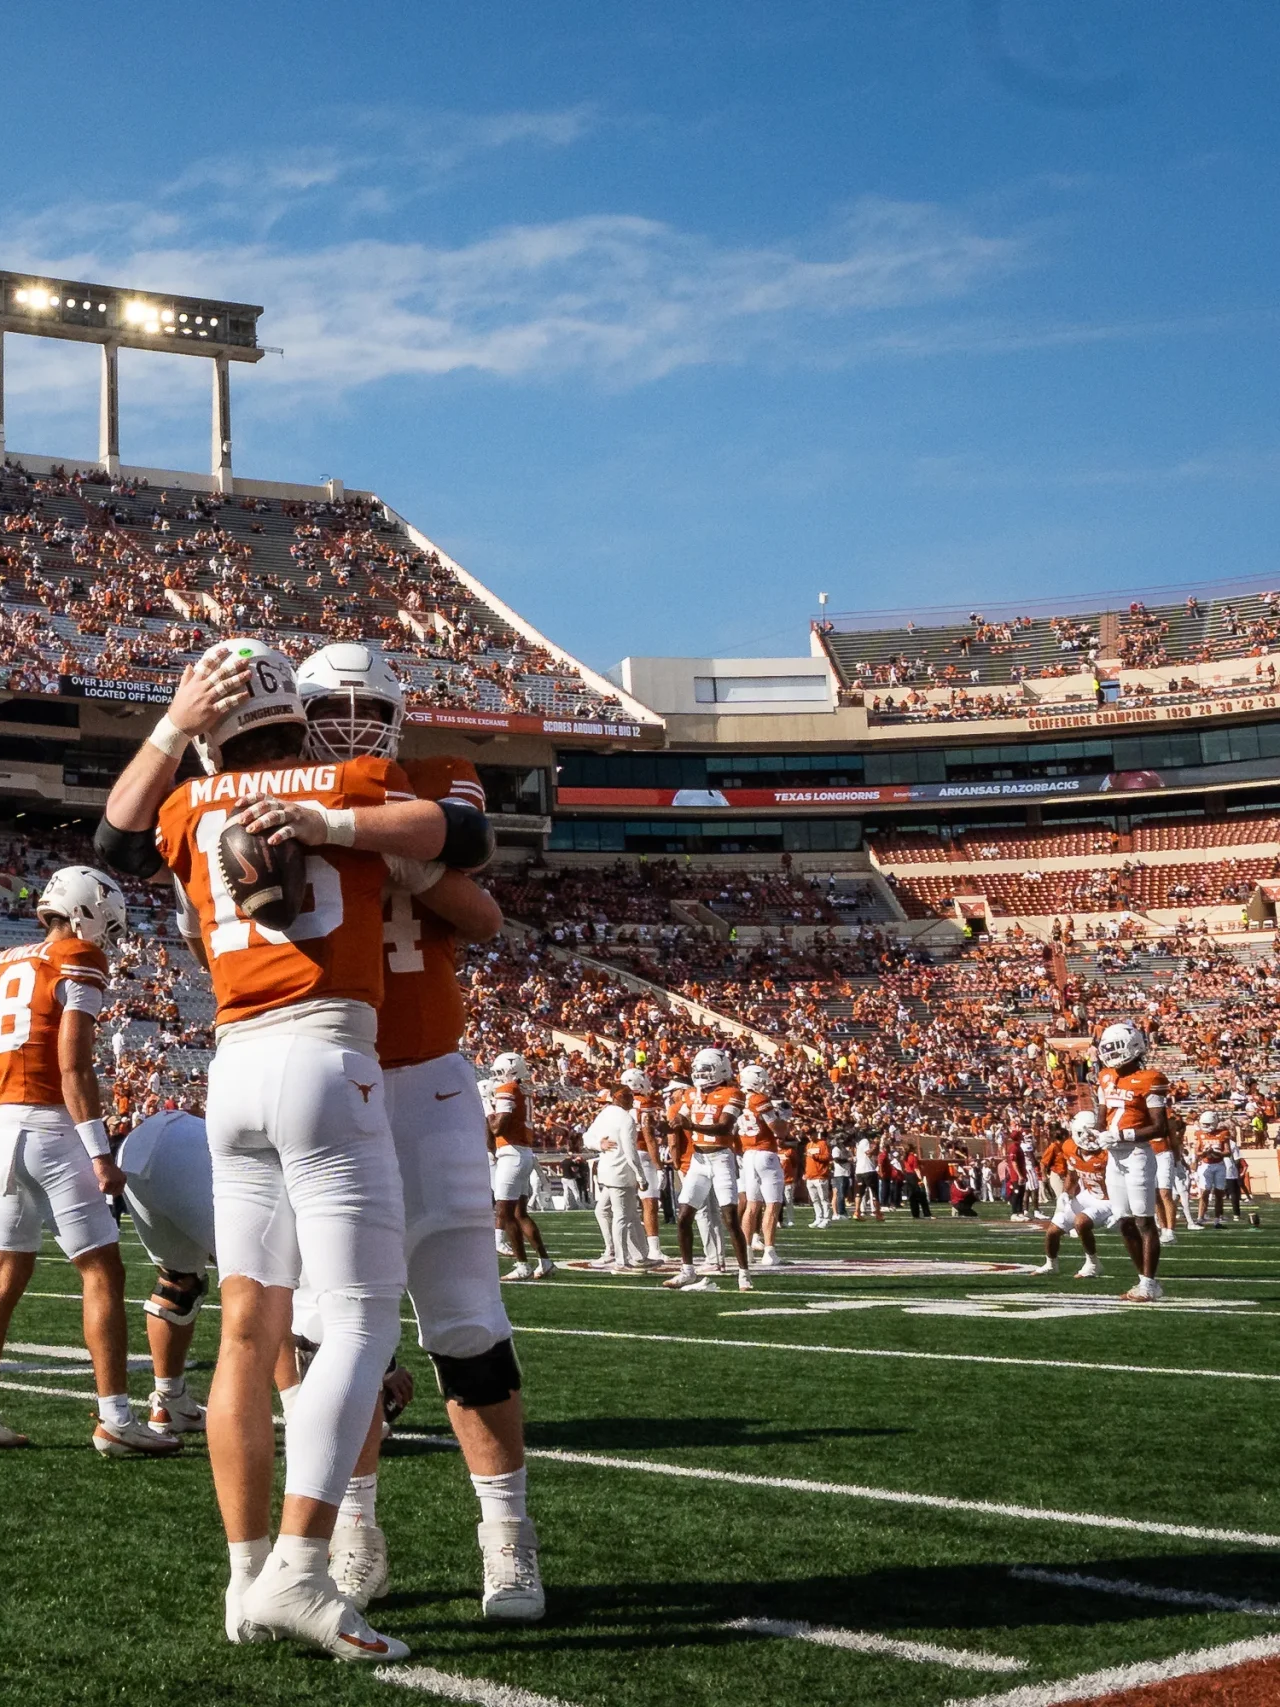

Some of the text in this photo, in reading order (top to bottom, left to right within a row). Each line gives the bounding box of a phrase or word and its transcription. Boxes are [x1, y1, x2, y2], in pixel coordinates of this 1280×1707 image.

[71, 676, 97, 687] OVER
[99, 679, 115, 689] 130
[116, 681, 151, 693] STORES
[153, 685, 173, 694] AND
[85, 687, 126, 700] LOCATED
[128, 692, 146, 701] OFF
[237, 704, 294, 727] LONGHORNS
[436, 714, 456, 723] TEXAS
[456, 716, 477, 725] STOCK
[477, 717, 509, 727] EXCHANGE
[1028, 715, 1093, 730] CONFERENCE
[1095, 709, 1157, 725] CHAMPIONS
[543, 720, 641, 737] SCORES AROUND THE BIG 12
[191, 765, 337, 808] MANNING
[939, 780, 1080, 797] ARKANSAS RAZORBACKS
[774, 791, 880, 801] TEXAS LONGHORNS
